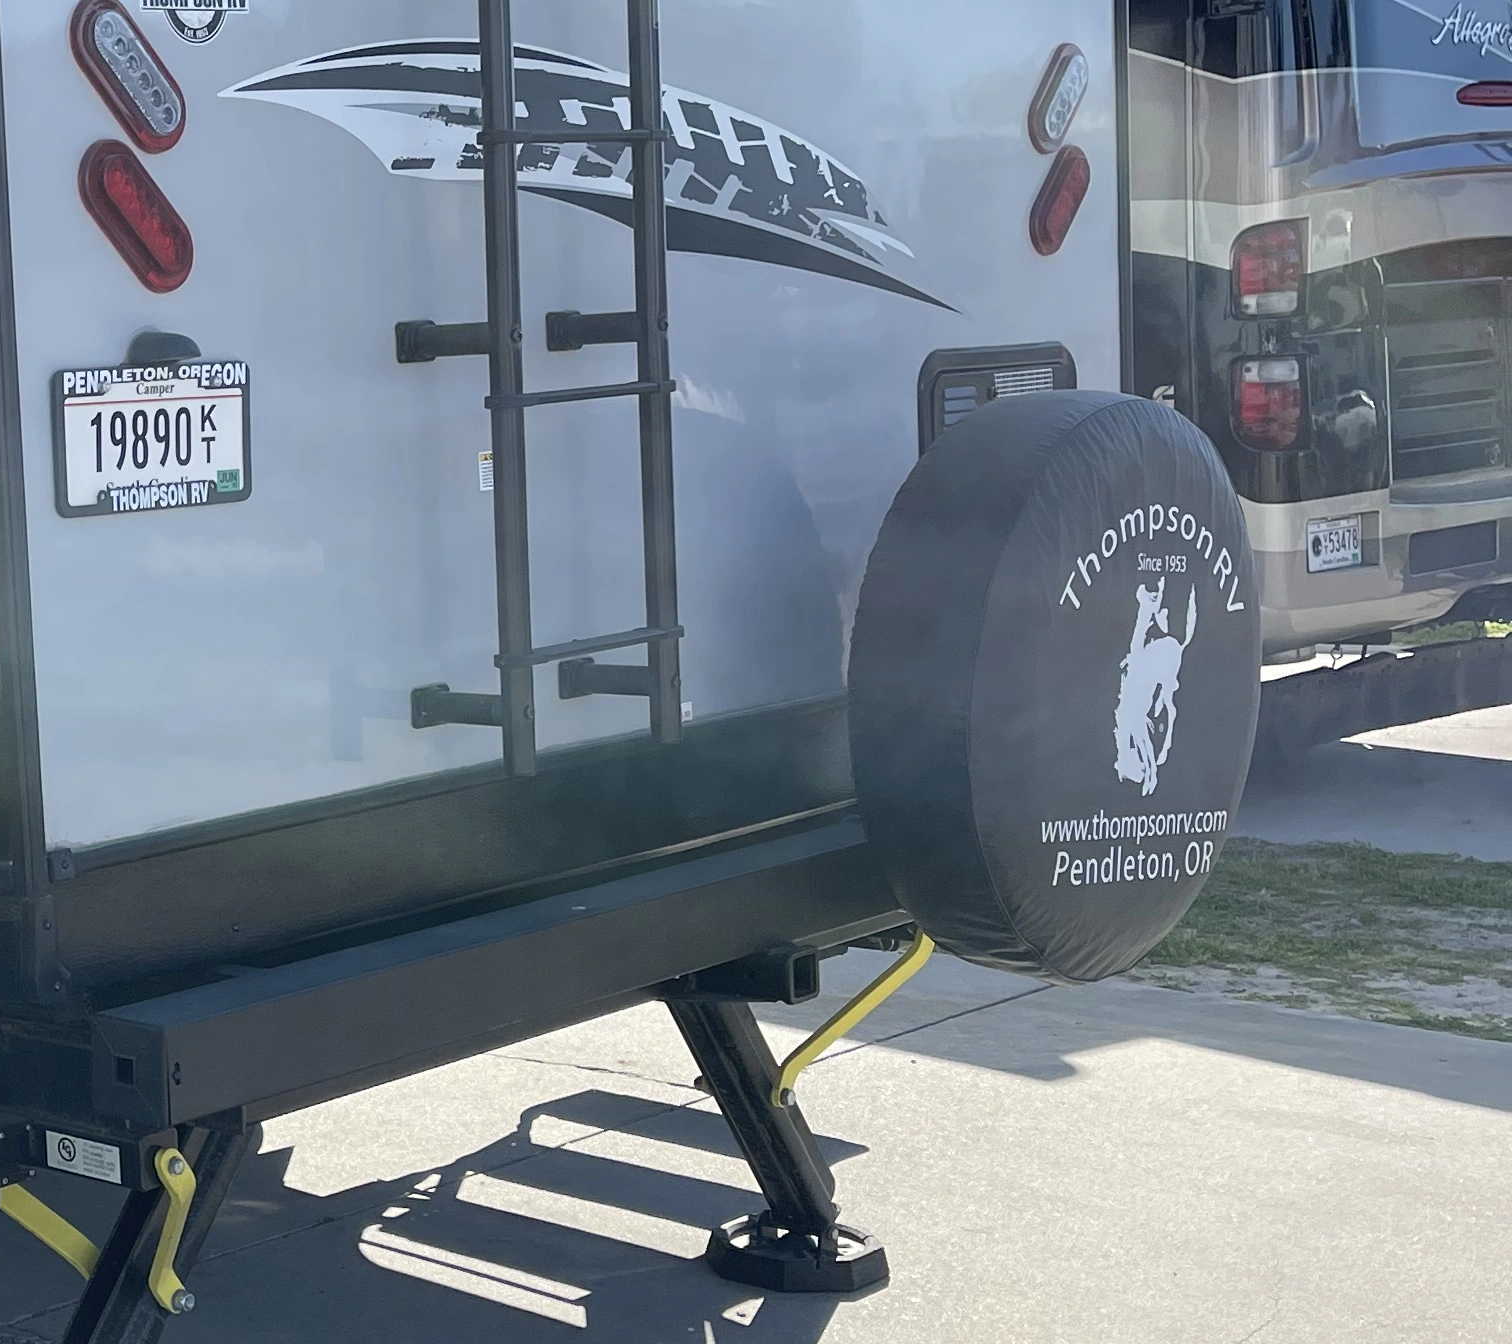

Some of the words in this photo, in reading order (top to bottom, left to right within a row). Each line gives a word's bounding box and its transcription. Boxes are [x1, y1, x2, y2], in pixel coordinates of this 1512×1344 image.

[1430, 1, 1509, 57] Allegro
[136, 382, 175, 397] Camper
[90, 406, 192, 473] 19890
[110, 485, 188, 512] THOMPSON
[191, 481, 209, 504] RV
[1059, 503, 1214, 610] Thompson
[1212, 547, 1245, 612] RV
[1328, 528, 1359, 554] 53478
[1137, 552, 1162, 571] Since
[1164, 555, 1187, 573] 1953
[1041, 809, 1228, 845] www.thompsonrv.com
[1052, 845, 1180, 887] Pendleton,
[1185, 840, 1214, 876] OR
